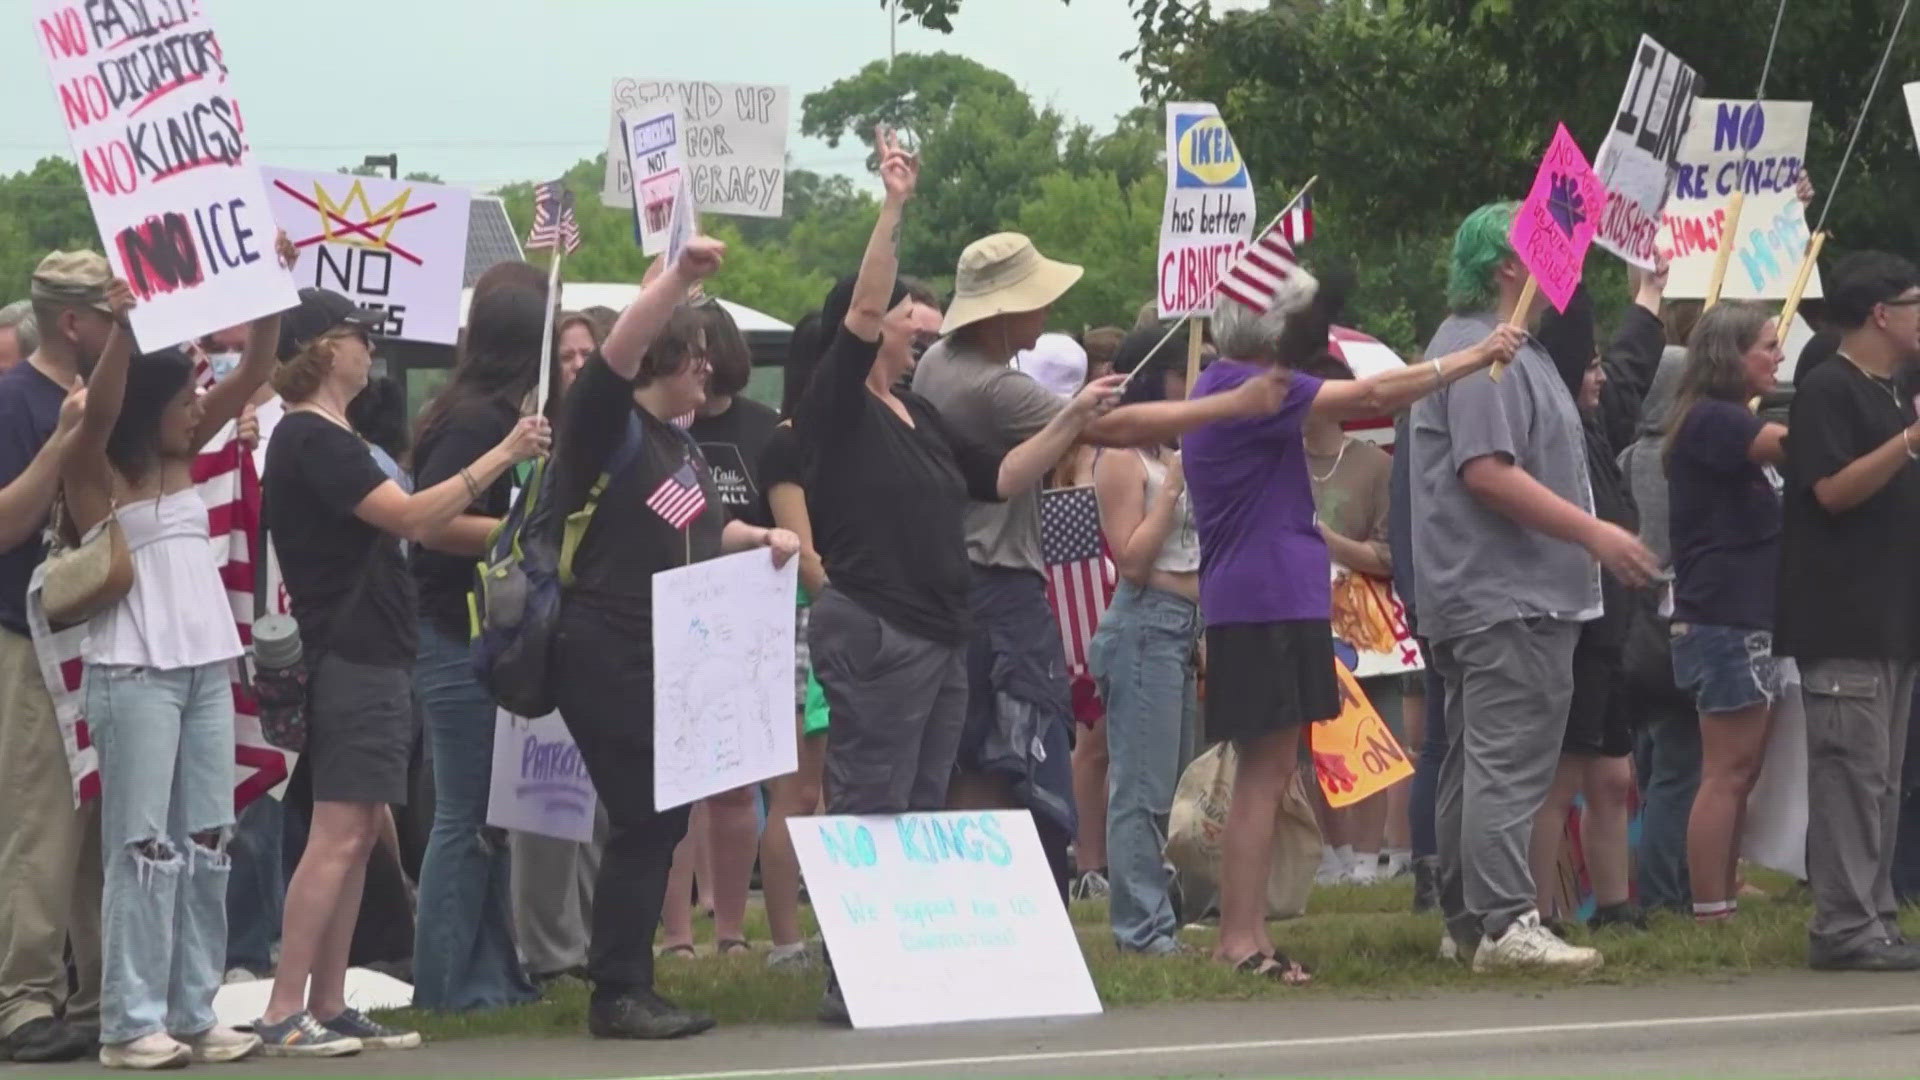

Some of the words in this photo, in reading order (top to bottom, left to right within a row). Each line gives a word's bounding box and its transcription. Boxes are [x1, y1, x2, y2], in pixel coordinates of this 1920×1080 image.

[41, 8, 88, 59] NO
[85, 0, 199, 48] FASIST
[60, 75, 109, 130] NO
[614, 76, 723, 122] SND
[735, 87, 776, 124] UP
[1616, 43, 1657, 136] I
[83, 141, 137, 195] NO
[126, 96, 249, 175] KINGS!
[685, 123, 734, 157] FOR
[1190, 126, 1235, 166] IKEA
[1714, 102, 1765, 152] NO
[617, 161, 780, 211] DCRACY
[647, 151, 667, 175] NOT
[1675, 163, 1709, 200] RE
[1171, 198, 1194, 233] has
[1200, 194, 1246, 234] better
[117, 212, 202, 300] NO
[194, 197, 260, 275] ICE
[315, 245, 392, 296] NO
[1161, 240, 1245, 313] CABINET
[722, 492, 750, 504] ALL
[818, 820, 878, 868] NO
[894, 813, 1014, 867] KINGS
